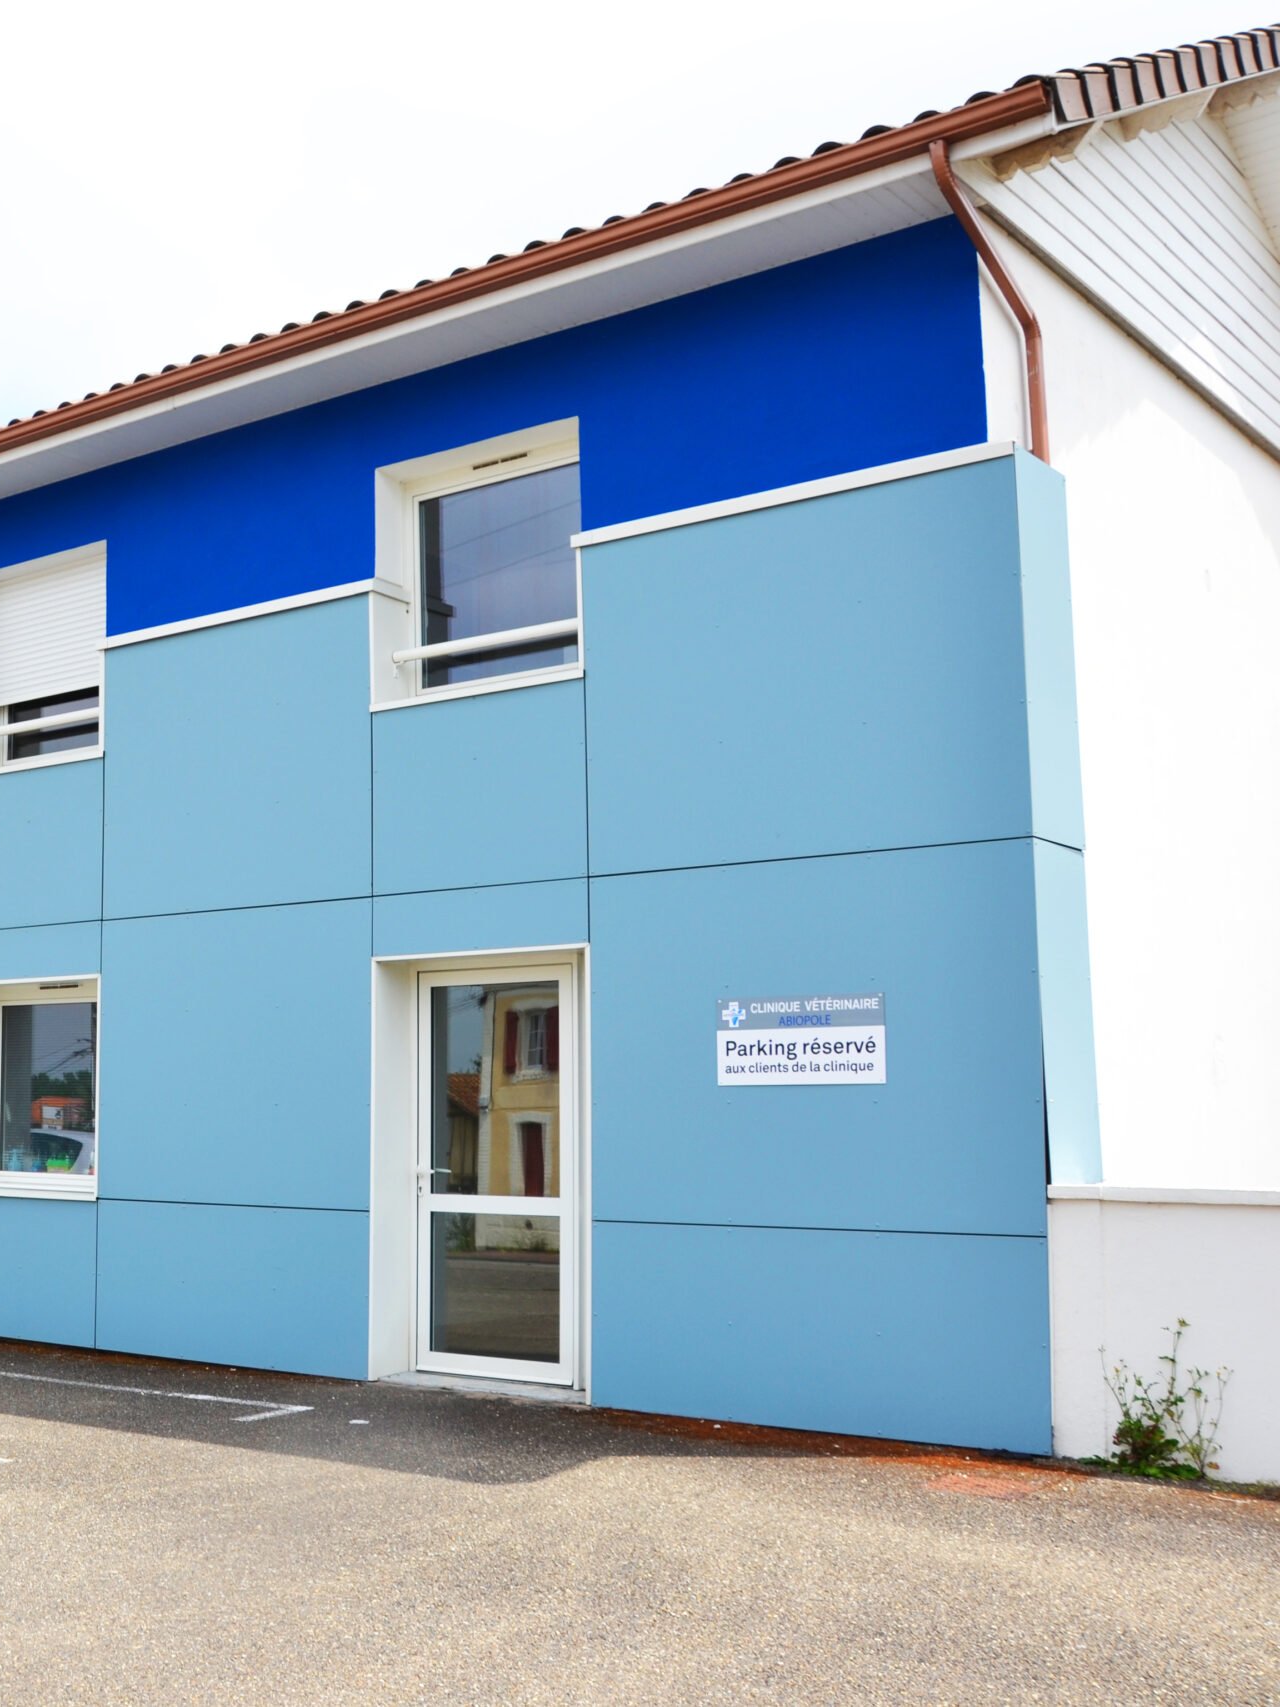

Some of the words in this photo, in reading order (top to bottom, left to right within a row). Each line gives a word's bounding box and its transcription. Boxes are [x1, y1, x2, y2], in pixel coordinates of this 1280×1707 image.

[750, 1001, 801, 1014] CLINIQUE
[804, 997, 880, 1012] VÉTÉRINAIRE
[778, 1014, 832, 1026] ABIOPOLE
[725, 1039, 798, 1060] Parking
[802, 1036, 877, 1055] réservé
[725, 1064, 747, 1074] aux
[748, 1062, 789, 1074] clients
[791, 1061, 807, 1073] de
[809, 1060, 821, 1072] la
[823, 1060, 875, 1074] clinique
